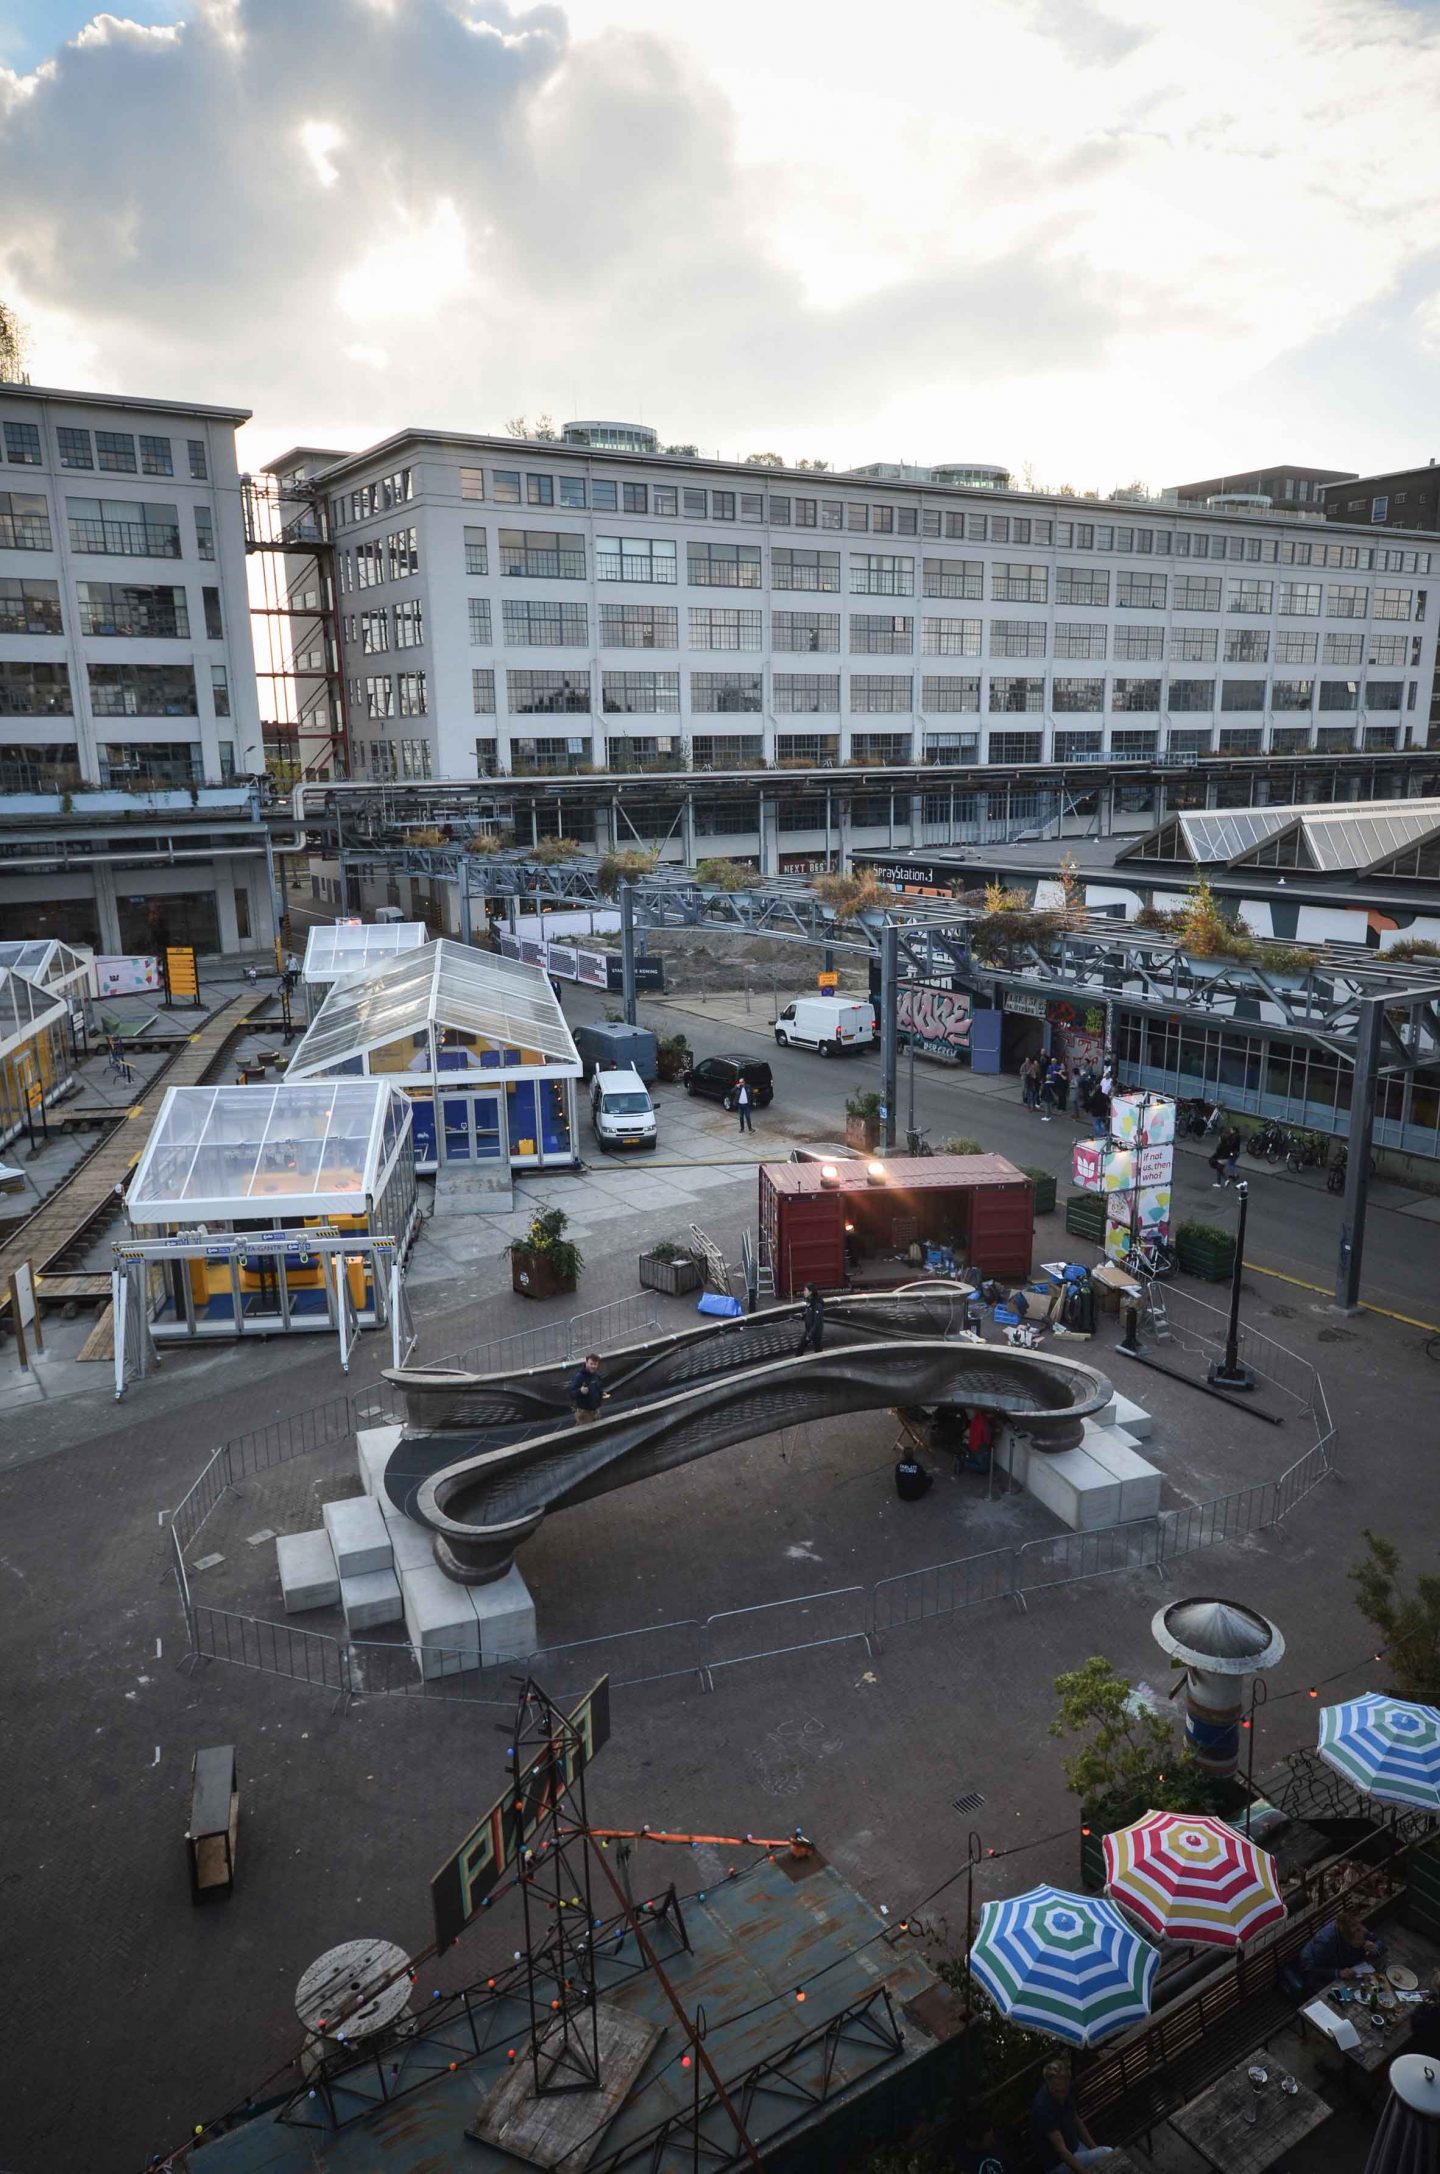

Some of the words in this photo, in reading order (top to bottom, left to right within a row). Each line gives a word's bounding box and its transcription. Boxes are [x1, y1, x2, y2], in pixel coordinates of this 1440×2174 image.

[783, 863, 805, 874] NEXT
[873, 863, 933, 883] SprayStation.3
[1143, 1153, 1149, 1161] if
[1150, 1152, 1163, 1160] not
[1143, 1163, 1153, 1171] us,
[1154, 1161, 1171, 1170] then
[1142, 1172, 1162, 1181] who?
